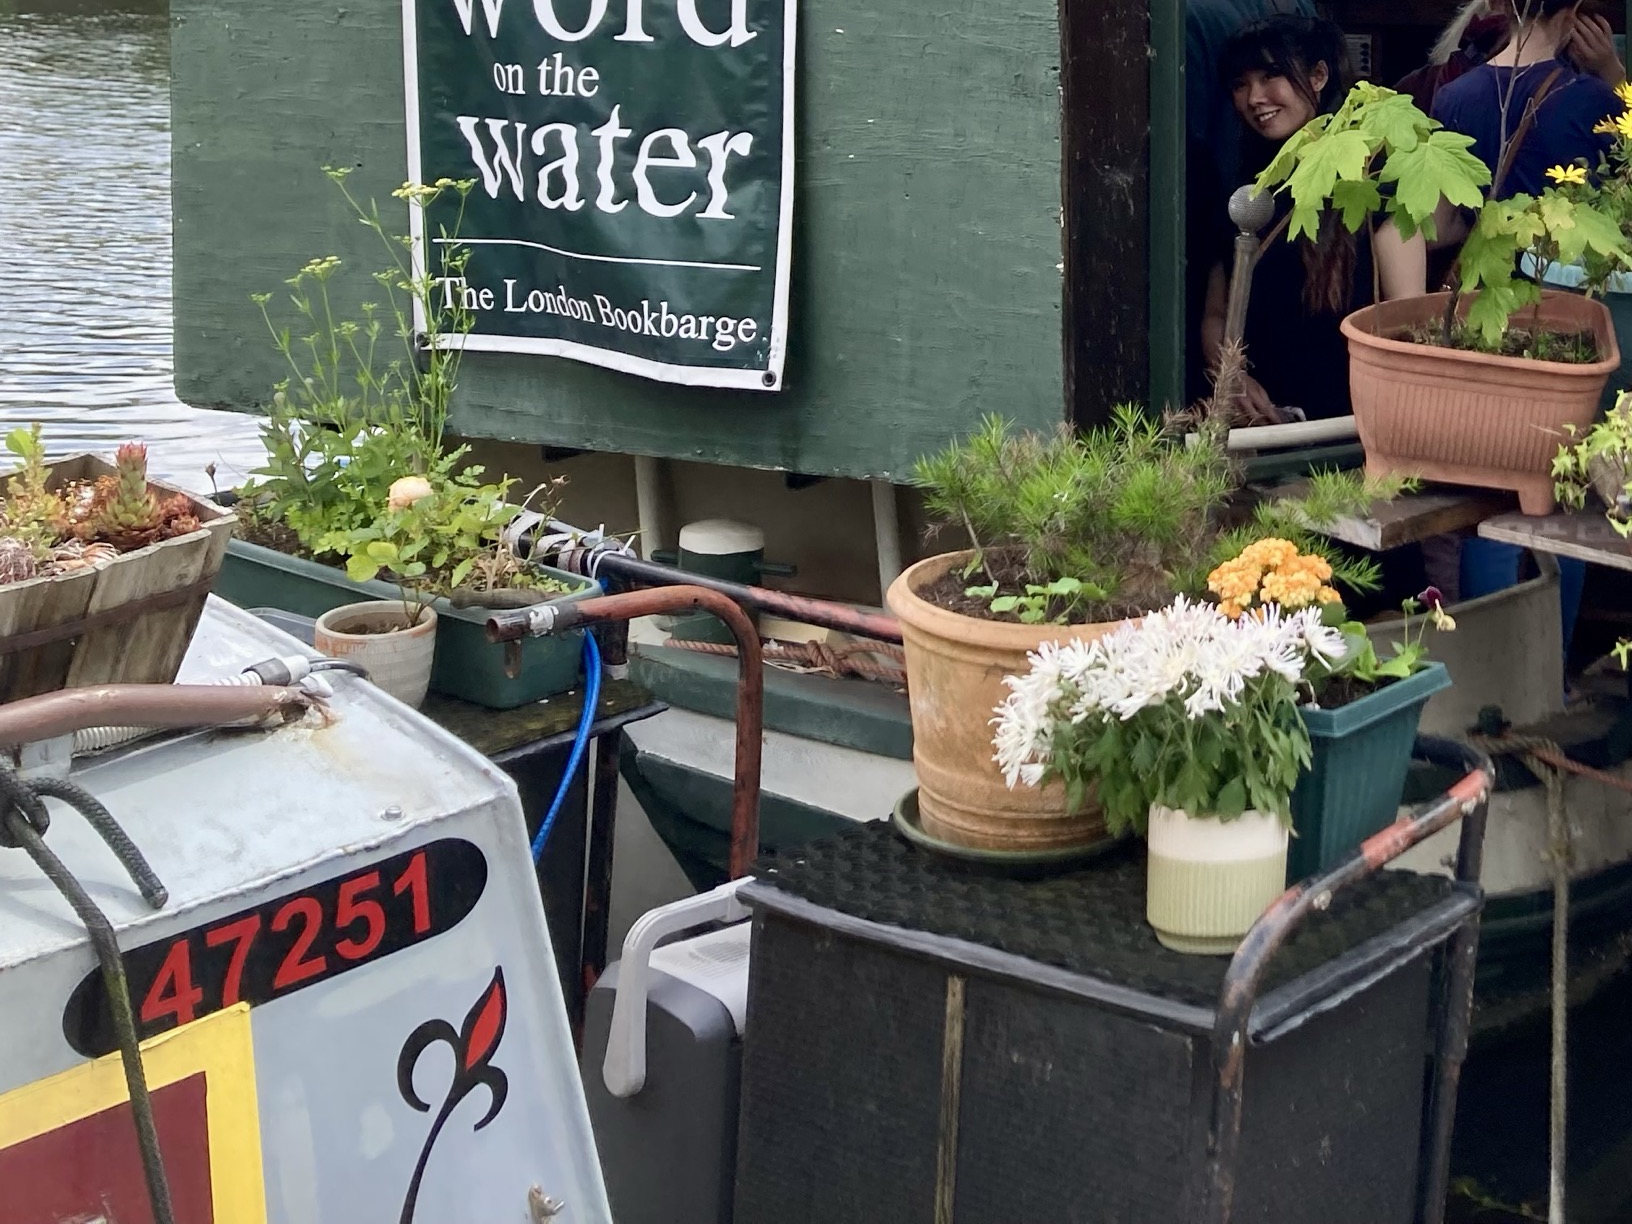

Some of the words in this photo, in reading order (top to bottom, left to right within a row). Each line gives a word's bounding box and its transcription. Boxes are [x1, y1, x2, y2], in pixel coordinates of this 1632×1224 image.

[493, 62, 526, 96] on
[537, 52, 600, 98] the
[456, 104, 755, 220] water
[435, 276, 495, 311] The
[504, 278, 595, 324] London
[594, 294, 757, 351] Bookbarge
[140, 851, 431, 1025] 47251
